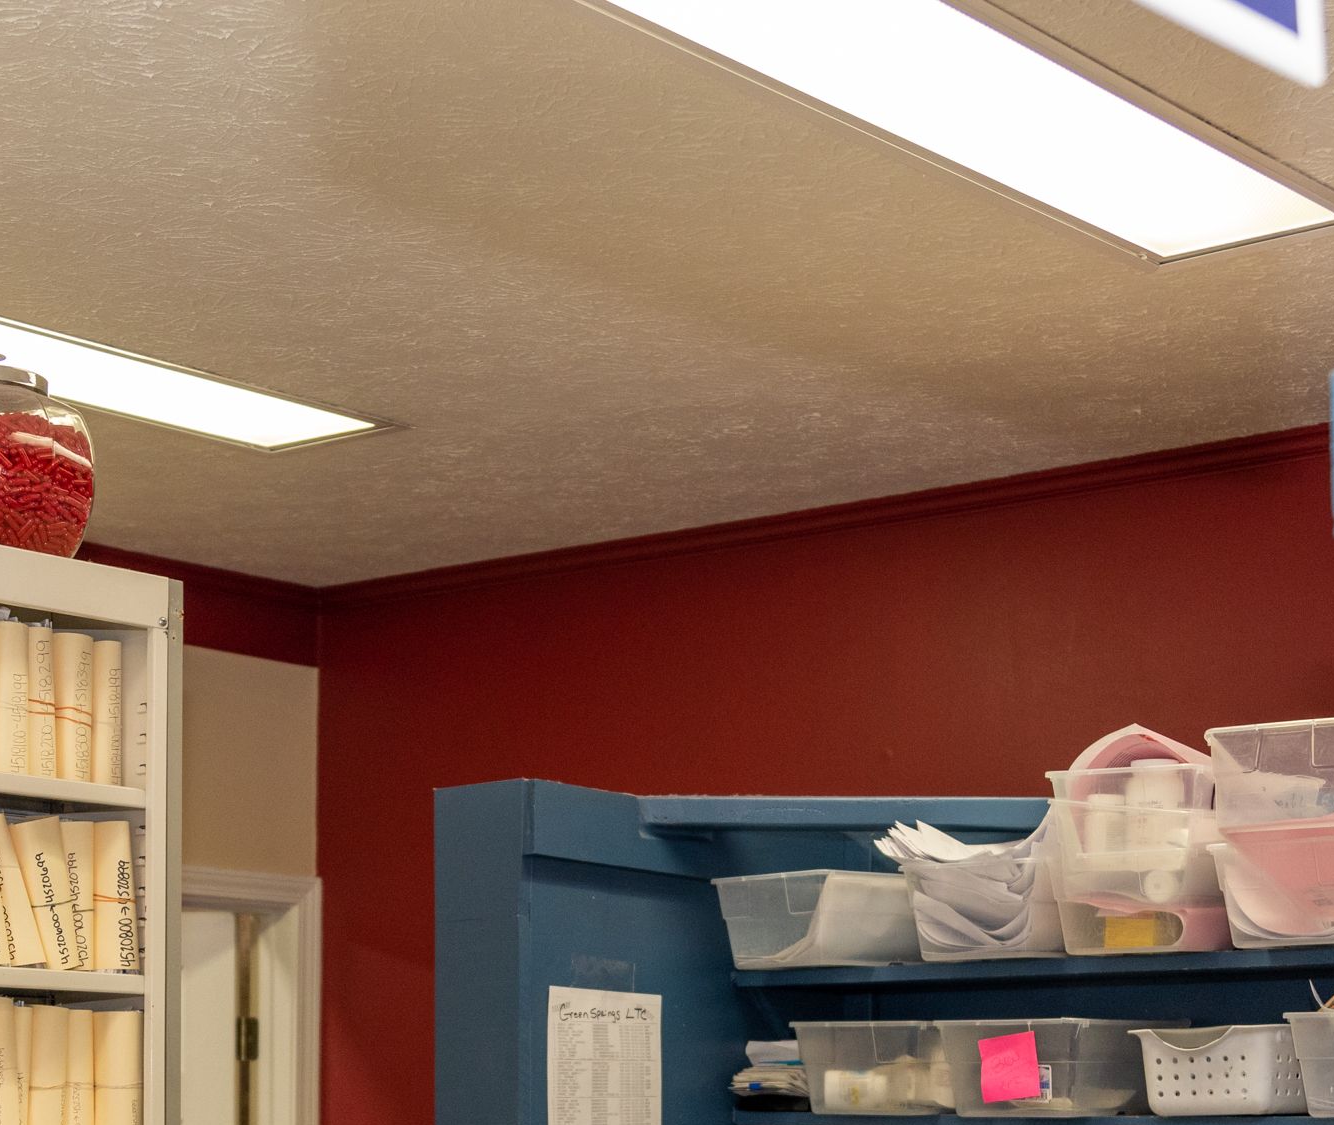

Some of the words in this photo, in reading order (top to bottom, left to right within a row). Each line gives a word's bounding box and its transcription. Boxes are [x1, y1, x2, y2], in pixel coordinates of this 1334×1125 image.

[34, 852, 56, 905] 4520699
[50, 914, 71, 966] 4520600
[117, 917, 136, 968] 4520800
[558, 1003, 588, 1021] Green
[590, 1008, 620, 1023] Springs
[626, 1008, 647, 1020] LTC
